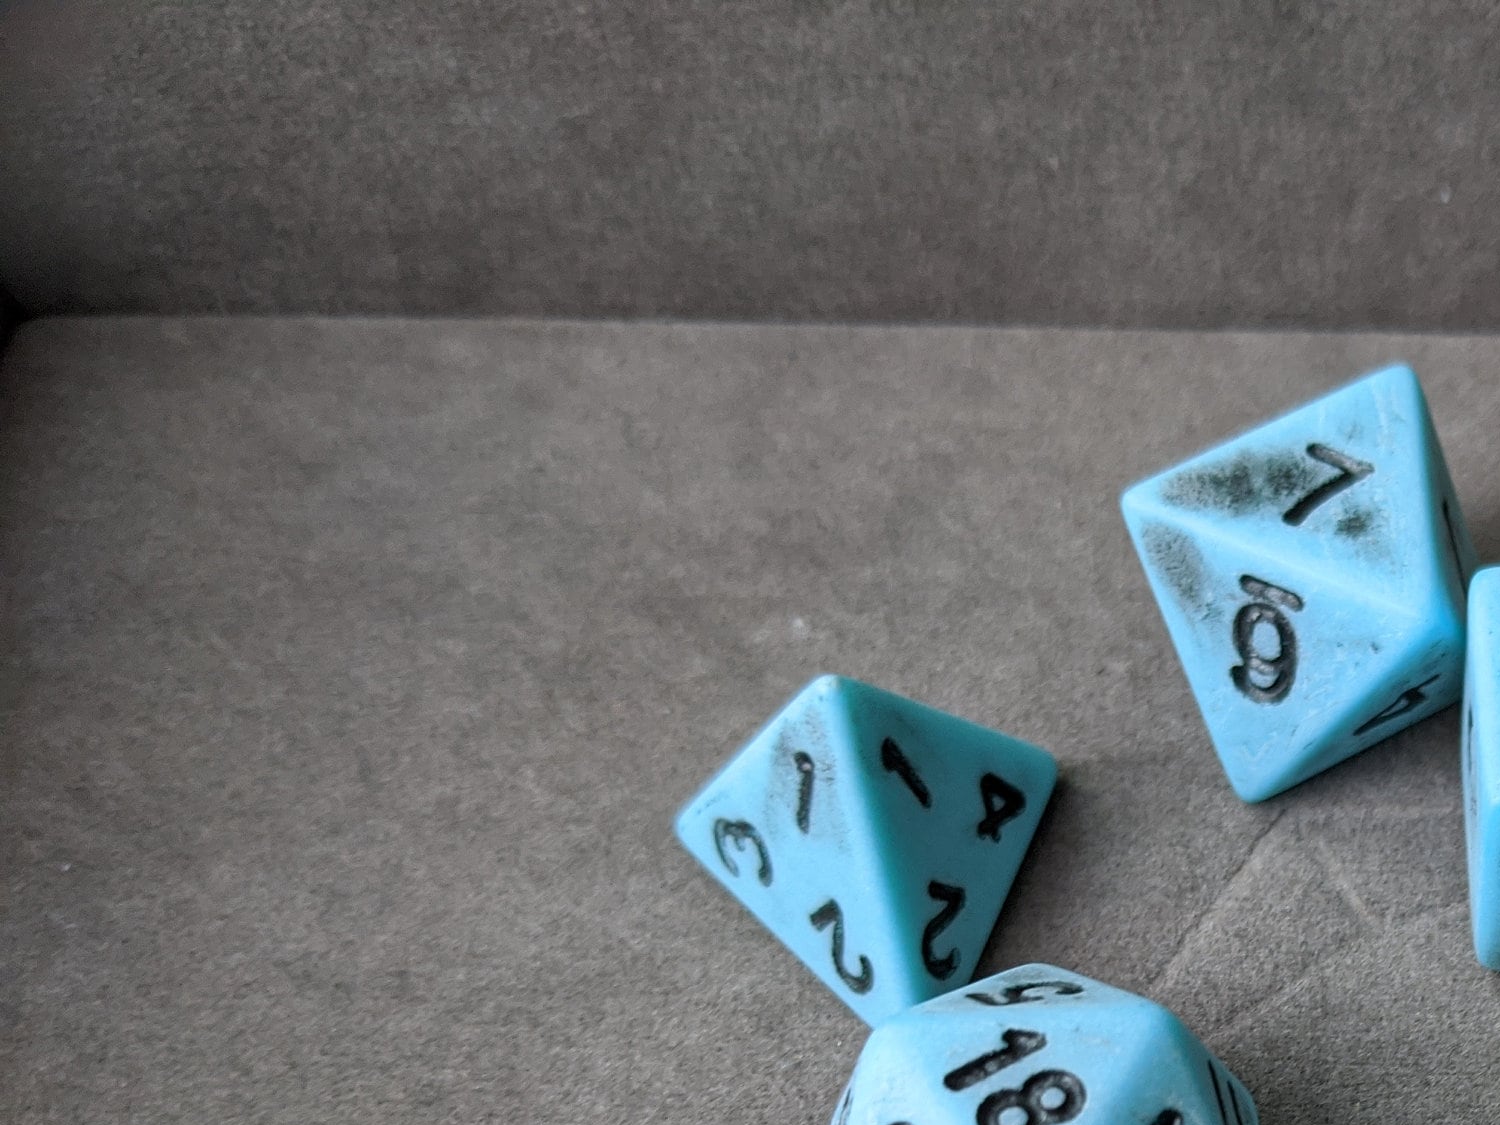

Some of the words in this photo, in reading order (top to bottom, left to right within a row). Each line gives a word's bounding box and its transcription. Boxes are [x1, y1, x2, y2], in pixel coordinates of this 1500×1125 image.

[1284, 443, 1376, 526] 7
[1230, 574, 1304, 704] 6
[794, 751, 815, 833] 1
[881, 736, 932, 809] 1
[977, 772, 1026, 844] 4
[714, 817, 773, 888] 3
[809, 899, 874, 995] 2
[922, 880, 967, 981] 2
[965, 981, 1085, 1007] 5
